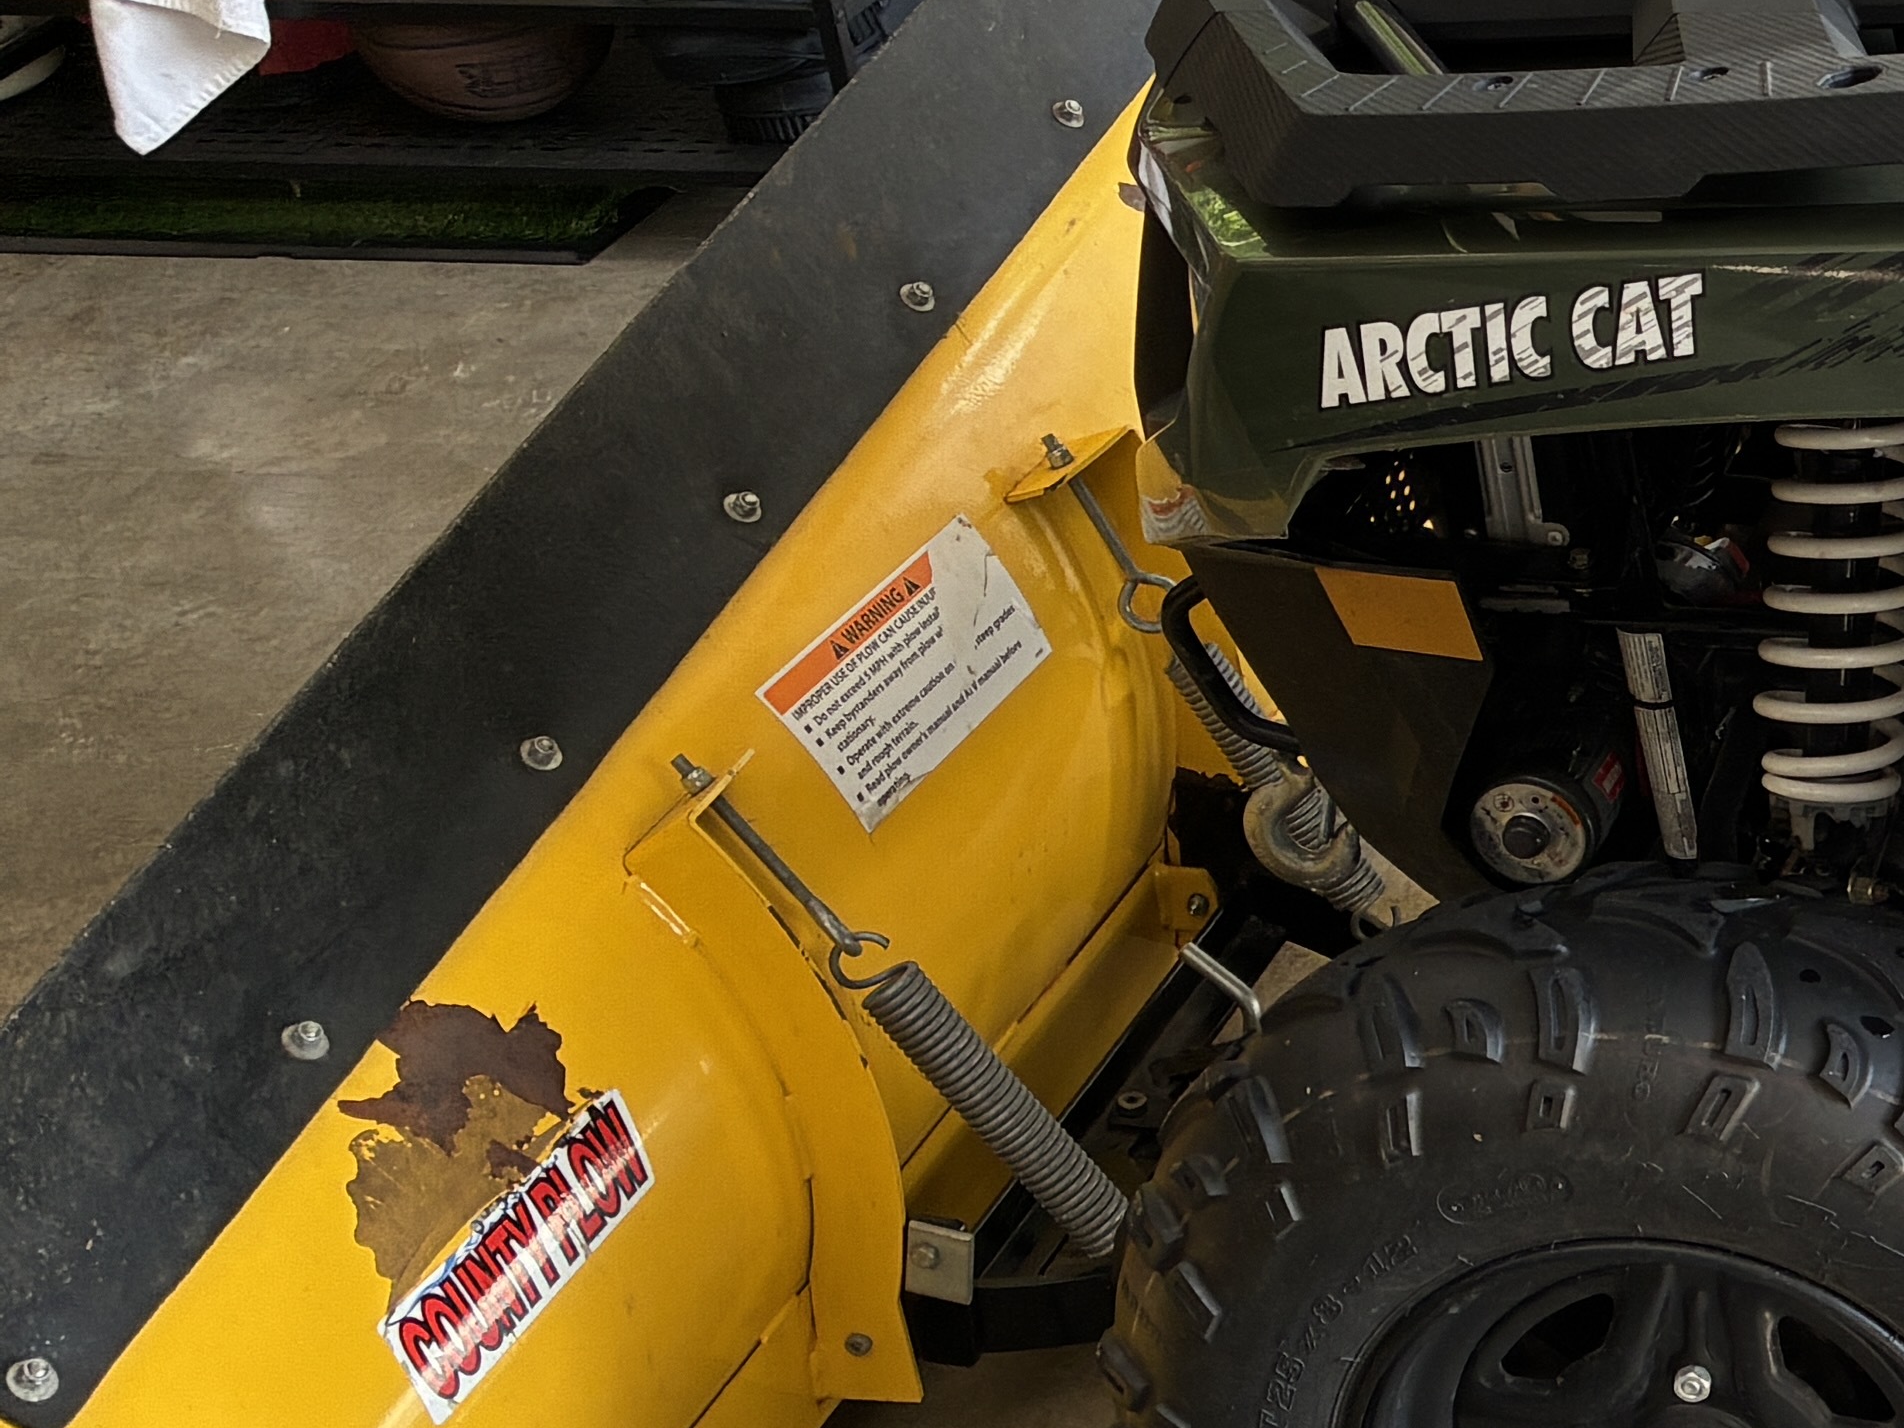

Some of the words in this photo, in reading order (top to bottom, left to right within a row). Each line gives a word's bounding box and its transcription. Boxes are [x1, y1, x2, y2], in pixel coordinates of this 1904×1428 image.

[1319, 294, 1552, 410] ARCTIC
[1570, 271, 1704, 372] CAT
[791, 680, 835, 722] IMPROPER
[829, 667, 849, 688] USE
[844, 658, 860, 675] OF
[855, 638, 881, 664] PLOW
[876, 623, 897, 645] CAN
[892, 602, 921, 631] CAUSE
[840, 585, 905, 647] WARNING
[813, 710, 828, 726] Do
[824, 698, 842, 716] not
[837, 675, 866, 704] exceed
[862, 670, 872, 681] 5
[867, 654, 889, 676] MPH
[885, 639, 905, 660] with
[900, 624, 923, 648] plow
[824, 716, 849, 741] Keep
[842, 681, 886, 724] bystanders
[844, 733, 878, 768] Operate
[873, 718, 893, 740] with
[889, 692, 921, 725] extreme
[398, 1196, 561, 1400] COUNTY
[527, 1099, 650, 1267] PLOW
